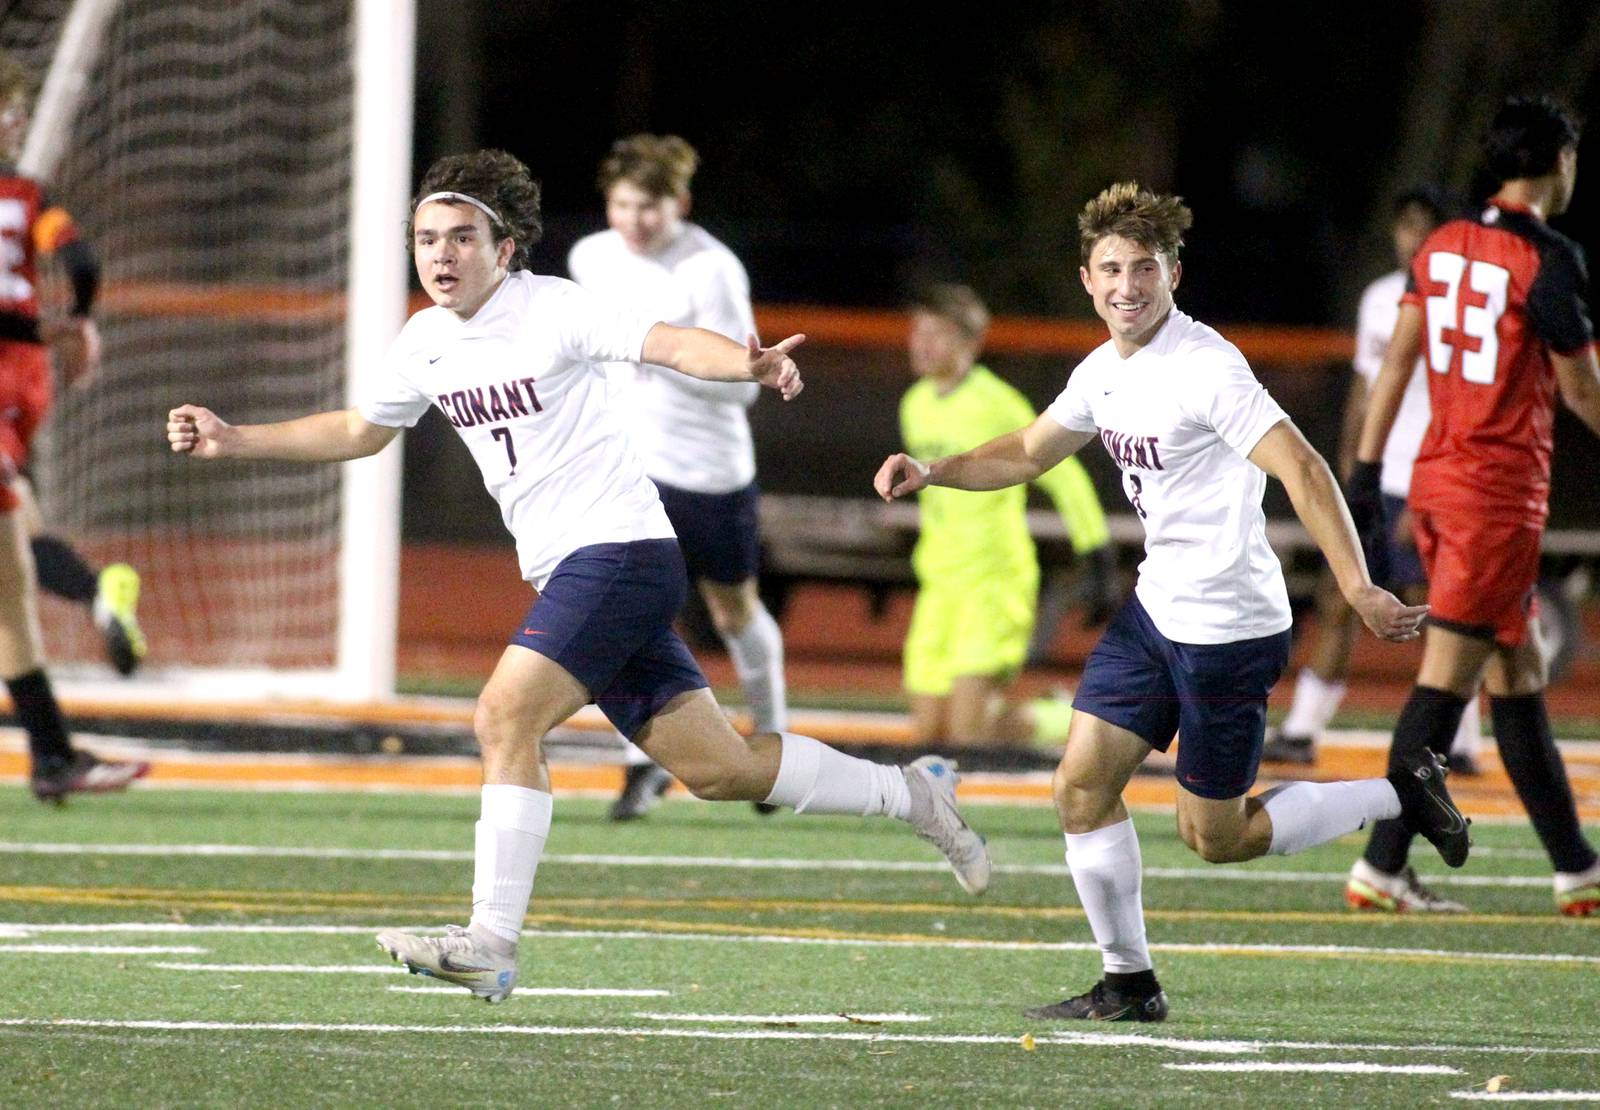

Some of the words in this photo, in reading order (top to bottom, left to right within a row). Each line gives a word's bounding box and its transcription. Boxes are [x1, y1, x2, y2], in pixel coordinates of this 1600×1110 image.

[1426, 251, 1510, 385] 23
[438, 377, 544, 428] CONANT
[490, 426, 518, 477] 7
[1096, 426, 1165, 470] ONANT
